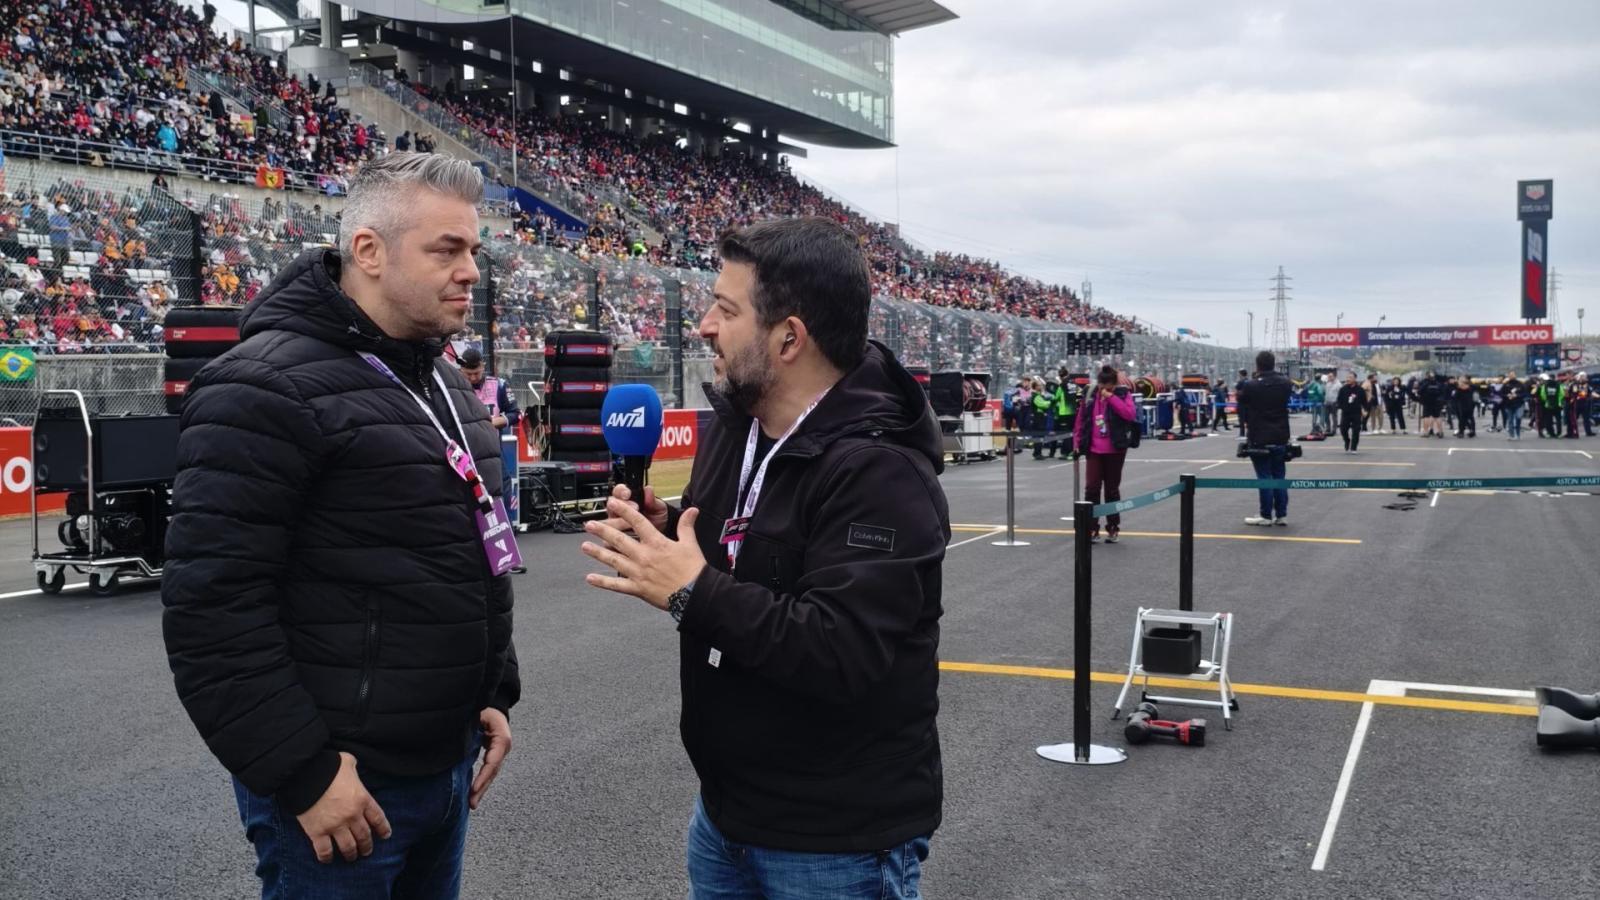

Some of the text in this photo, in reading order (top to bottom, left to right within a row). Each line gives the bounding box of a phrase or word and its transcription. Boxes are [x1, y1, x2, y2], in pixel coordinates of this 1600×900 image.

[1301, 331, 1354, 342] Lenovo
[1368, 330, 1478, 341] Smarter technology for all
[1492, 328, 1549, 340] Lenovo
